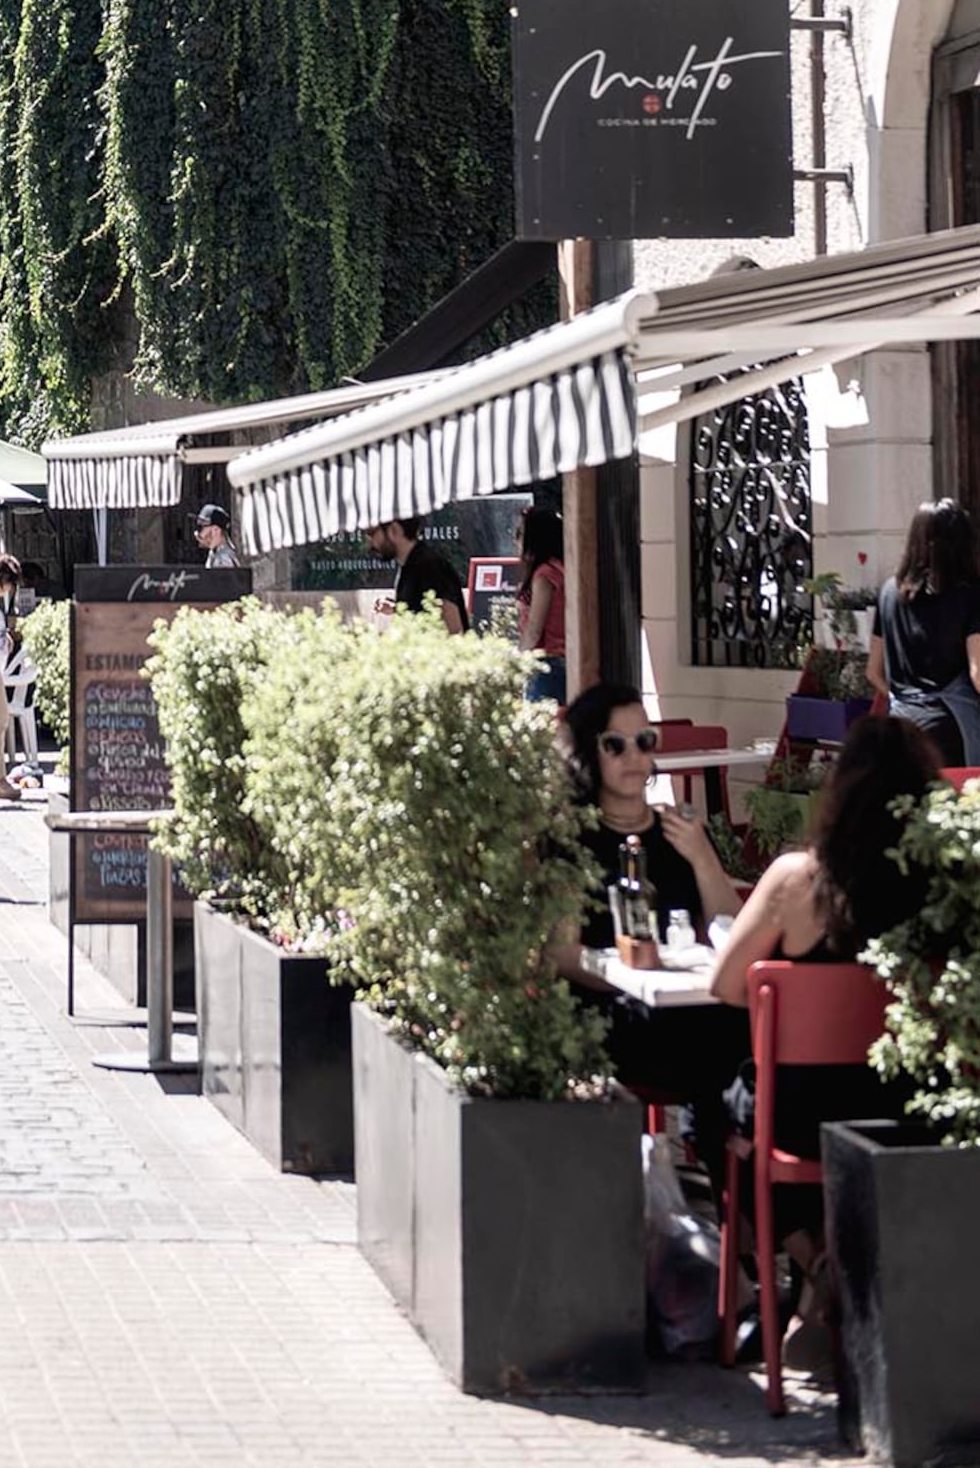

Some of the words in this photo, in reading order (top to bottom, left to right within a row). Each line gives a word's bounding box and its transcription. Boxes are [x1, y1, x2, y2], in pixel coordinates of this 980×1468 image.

[535, 37, 783, 142] Mulato
[597, 118, 640, 127] COCINA
[642, 118, 657, 126] DE
[85, 653, 146, 670] ESTAMO
